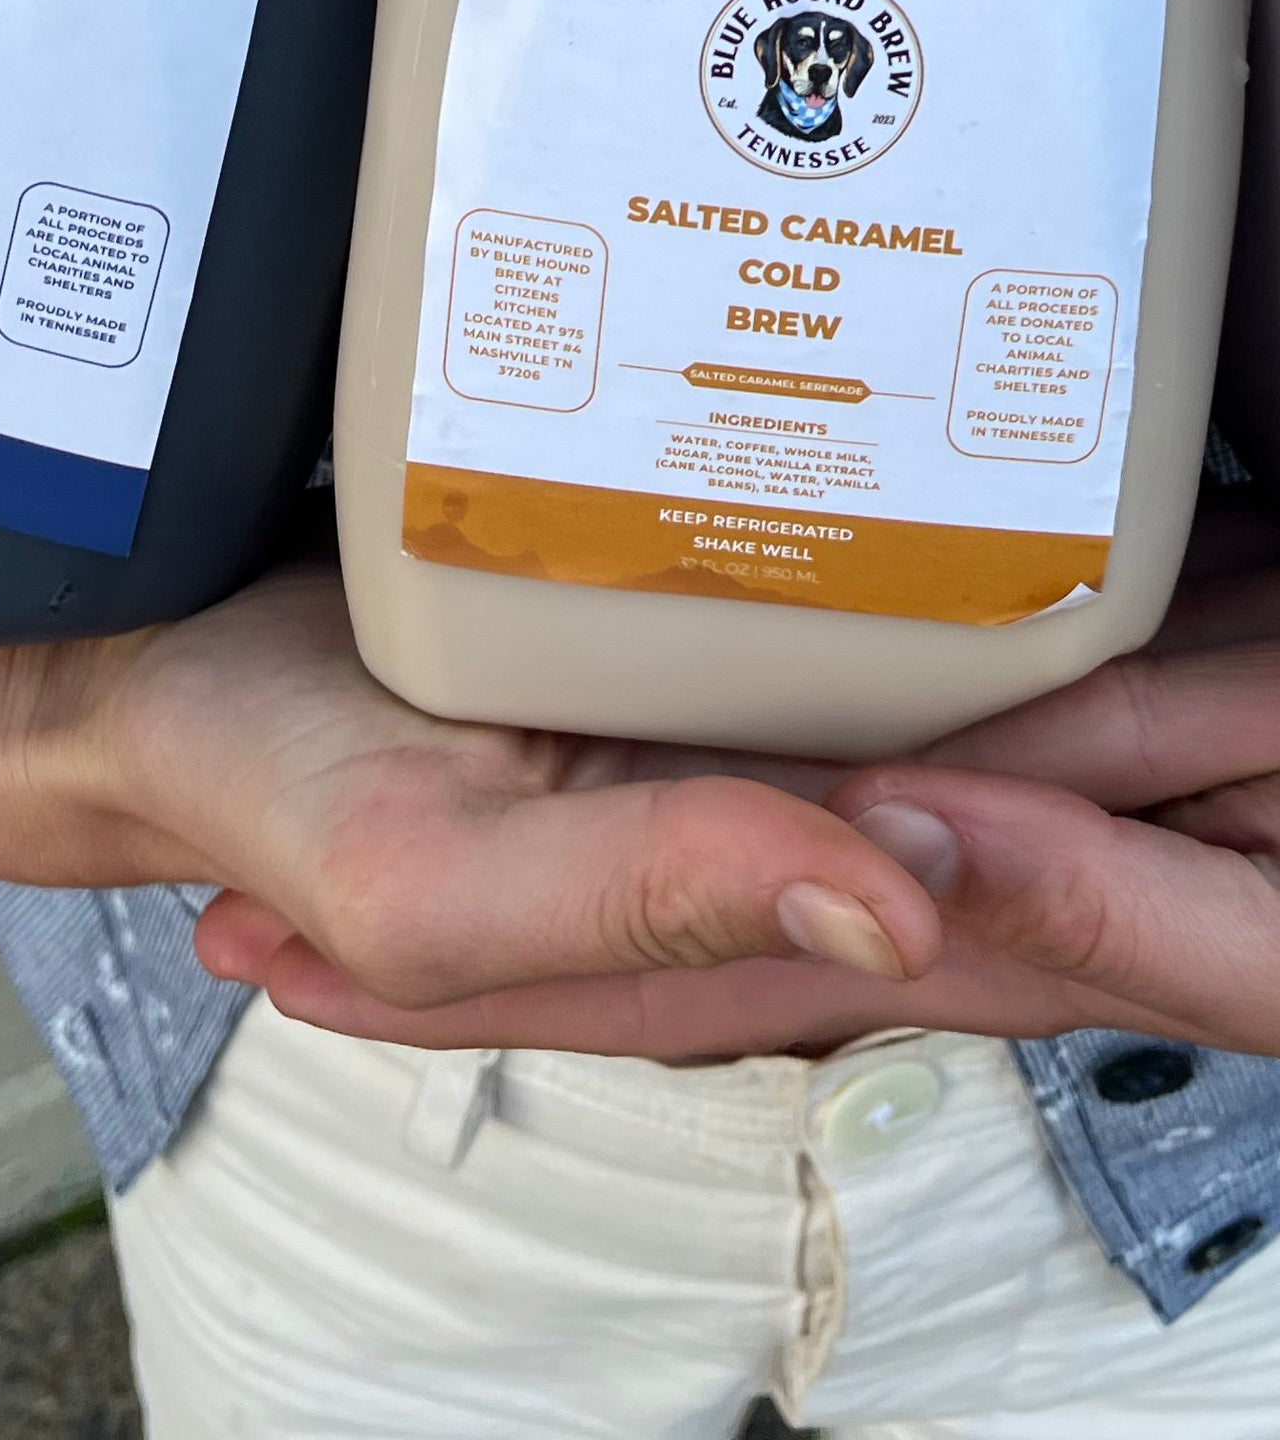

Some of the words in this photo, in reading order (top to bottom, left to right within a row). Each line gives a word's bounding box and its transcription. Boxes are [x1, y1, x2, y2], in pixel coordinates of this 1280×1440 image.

[711, 6, 758, 79] BLUE
[868, 9, 913, 98] BREW
[718, 97, 738, 109] Est.
[871, 113, 896, 125] 2023
[737, 122, 871, 168] TENNESSEE
[43, 202, 53, 213] A
[57, 205, 121, 229] PORTION
[125, 222, 145, 233] OF
[627, 196, 768, 235] SALTED
[780, 214, 962, 255] CARAMEL
[37, 216, 63, 230] ALL
[67, 223, 143, 248] PROCEEDS
[470, 230, 593, 258] MANUFACTURED
[25, 228, 53, 242] ARE
[57, 235, 126, 259] DONATED
[130, 252, 149, 263] TO
[32, 243, 77, 263] LOCAL
[81, 256, 135, 276] ANIMAL
[470, 246, 489, 258] BY
[493, 250, 530, 265] BLUE
[535, 257, 590, 274] HOUND
[28, 257, 99, 282] CHARITIES
[102, 276, 134, 289] AND
[495, 267, 539, 282] BREW
[543, 275, 562, 286] AT
[738, 258, 840, 291] COLD
[43, 275, 111, 299] SHELTERS
[494, 284, 558, 303] CITIZENS
[990, 283, 1001, 293] A
[1006, 283, 1073, 298] PORTION
[1077, 288, 1097, 299] OF
[16, 297, 82, 320] PROUDLY
[85, 314, 126, 331] MADE
[493, 300, 556, 319] KITCHEN
[985, 299, 1013, 310] ALL
[1018, 301, 1097, 315] PROCEEDS
[20, 312, 34, 323] IN
[38, 317, 115, 343] TENNESSEE
[464, 311, 532, 330] LOCATED
[535, 323, 554, 334] AT
[558, 326, 583, 339] 975
[726, 305, 842, 340] BREW
[985, 315, 1015, 326] ARE
[1020, 317, 1093, 331] DONATED
[463, 327, 500, 342] MAIN
[505, 334, 558, 350] STREET
[562, 343, 581, 354] #4
[1001, 331, 1021, 343] TO
[1025, 334, 1073, 347] LOCAL
[469, 344, 548, 365] NASHVILLE
[553, 357, 572, 368] TN
[1005, 349, 1063, 362] ANIMAL
[497, 364, 540, 380] 37206
[690, 369, 736, 381] SALTED
[738, 375, 795, 388] CARAMEL
[799, 381, 862, 395] SERENADE
[975, 363, 1052, 377] CHARITIES
[1056, 368, 1089, 379] AND
[993, 380, 1066, 394] SHELTERS
[709, 412, 827, 435] INGREDIENTS
[966, 410, 1037, 424] PROUDLY
[1041, 416, 1083, 427] MADE
[971, 426, 986, 436] IN
[991, 427, 1073, 442] TENNESSEE
[665, 447, 711, 461] SUGAR,
[716, 452, 750, 464] PURE
[755, 457, 810, 471] VANILLA
[815, 463, 874, 477] EXTRACT
[671, 434, 721, 448] WATER,
[725, 440, 779, 455] COFFEE,
[784, 446, 831, 459] WHOLE
[836, 452, 871, 464] MILK,
[655, 458, 695, 470] (CANE
[698, 464, 764, 480] ALCOHOL,
[769, 471, 819, 485] WATER,
[825, 477, 880, 490] VANILLA
[707, 478, 759, 493] BEANS),
[764, 484, 788, 494] SEA
[792, 487, 824, 498] SALT
[659, 508, 707, 524] KEEP
[712, 514, 853, 540] REFRIGERATED
[693, 536, 756, 554] SHAKE
[761, 543, 812, 560] WELL
